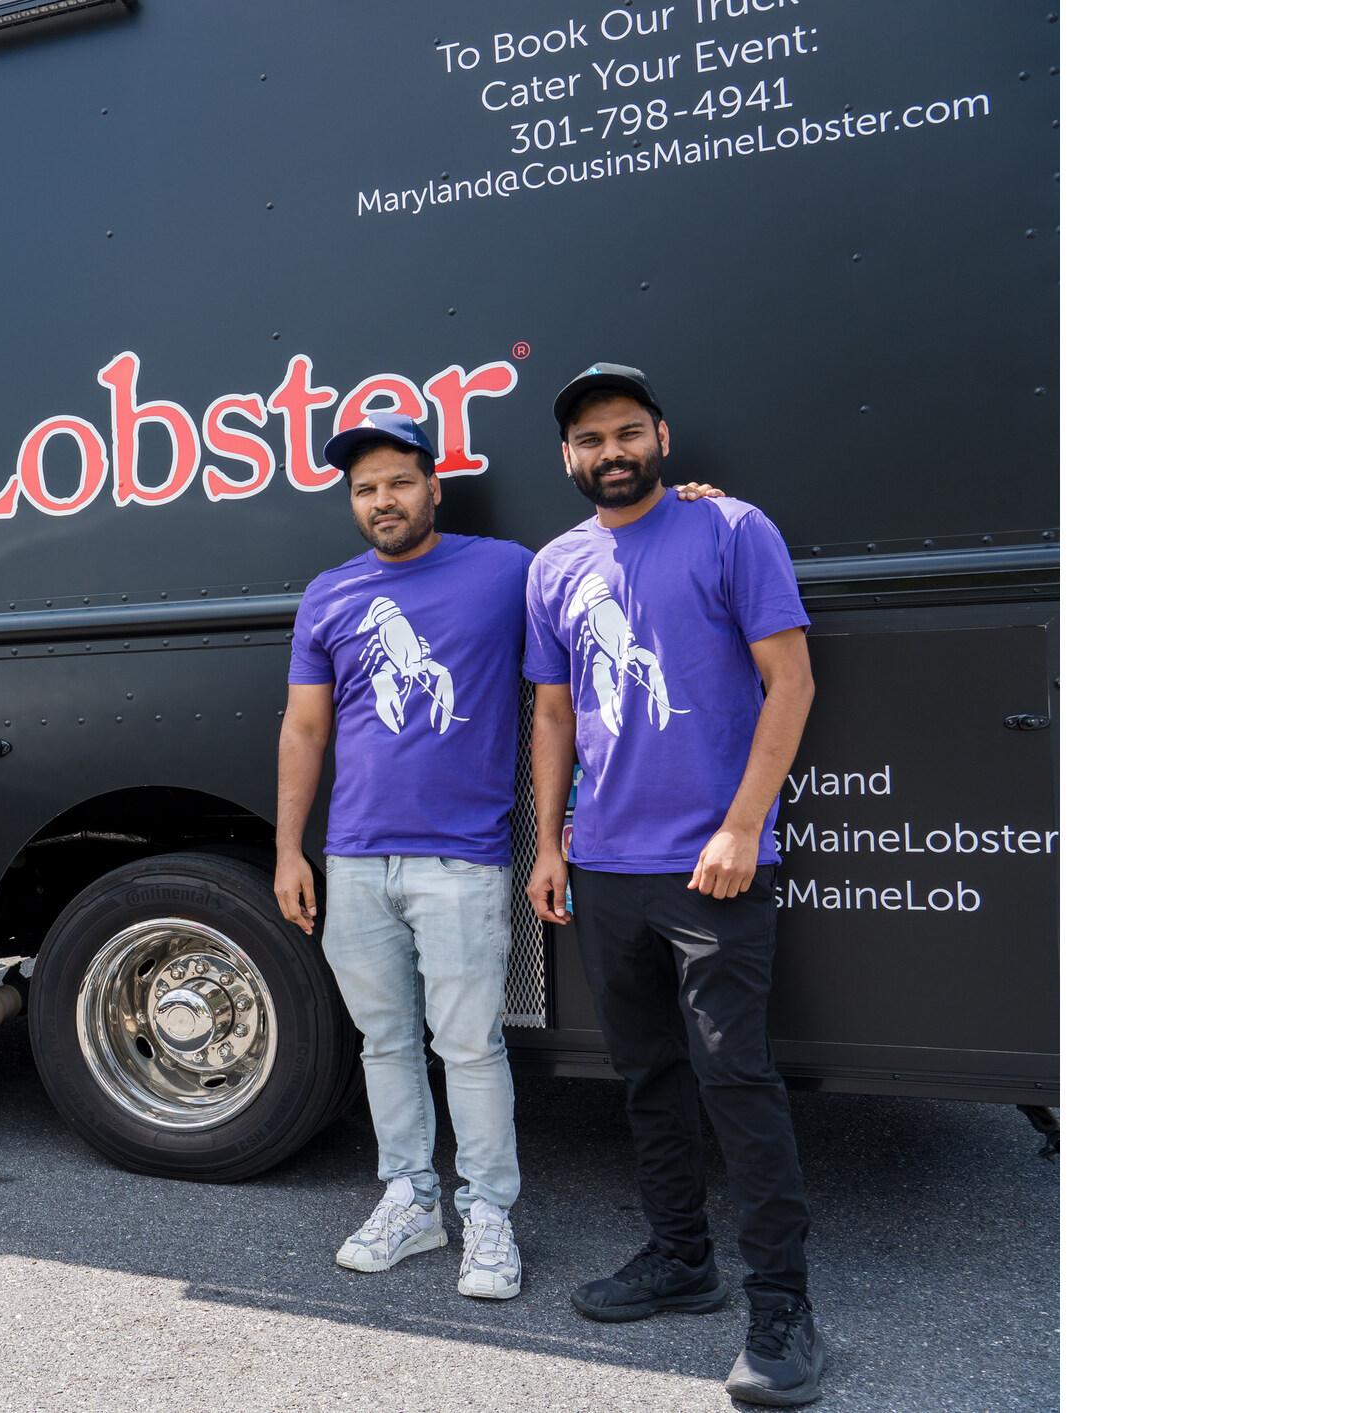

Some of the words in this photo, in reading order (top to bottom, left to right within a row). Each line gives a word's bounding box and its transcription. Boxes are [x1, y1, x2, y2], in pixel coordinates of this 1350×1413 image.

[436, 42, 480, 73] To
[494, 19, 589, 63] Book
[601, 6, 675, 41] Our
[696, 0, 800, 23] Truc
[481, 73, 581, 111] Cater
[592, 54, 681, 90] Your
[696, 26, 818, 73] Event:
[510, 77, 793, 154] 301-798-4941
[357, 93, 991, 216] Maryland@CousinsMaineLobster.com
[125, 884, 211, 908] Continental
